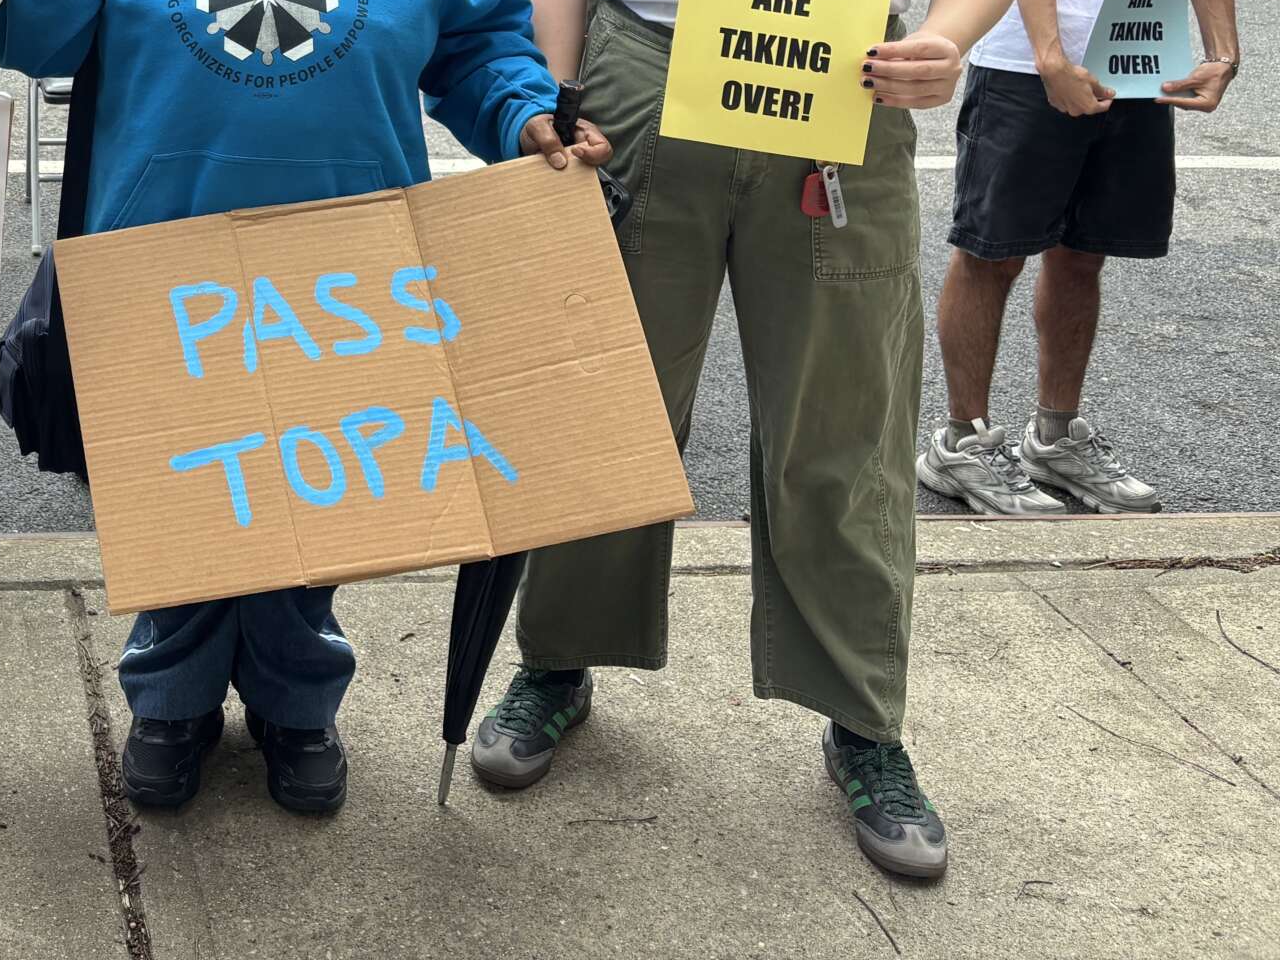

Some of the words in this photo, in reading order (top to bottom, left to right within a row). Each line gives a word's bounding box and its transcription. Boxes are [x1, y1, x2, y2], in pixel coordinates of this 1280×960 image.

[171, 12, 241, 83] ORGANIZERS
[244, 74, 274, 88] FOR
[279, 57, 334, 87] PEOPLE
[720, 27, 832, 74] TAKING
[1109, 21, 1163, 41] TAKING
[1108, 54, 1160, 75] OVER!
[721, 80, 814, 122] OVER!
[169, 266, 462, 379] PASS
[168, 397, 519, 528] TOPA
